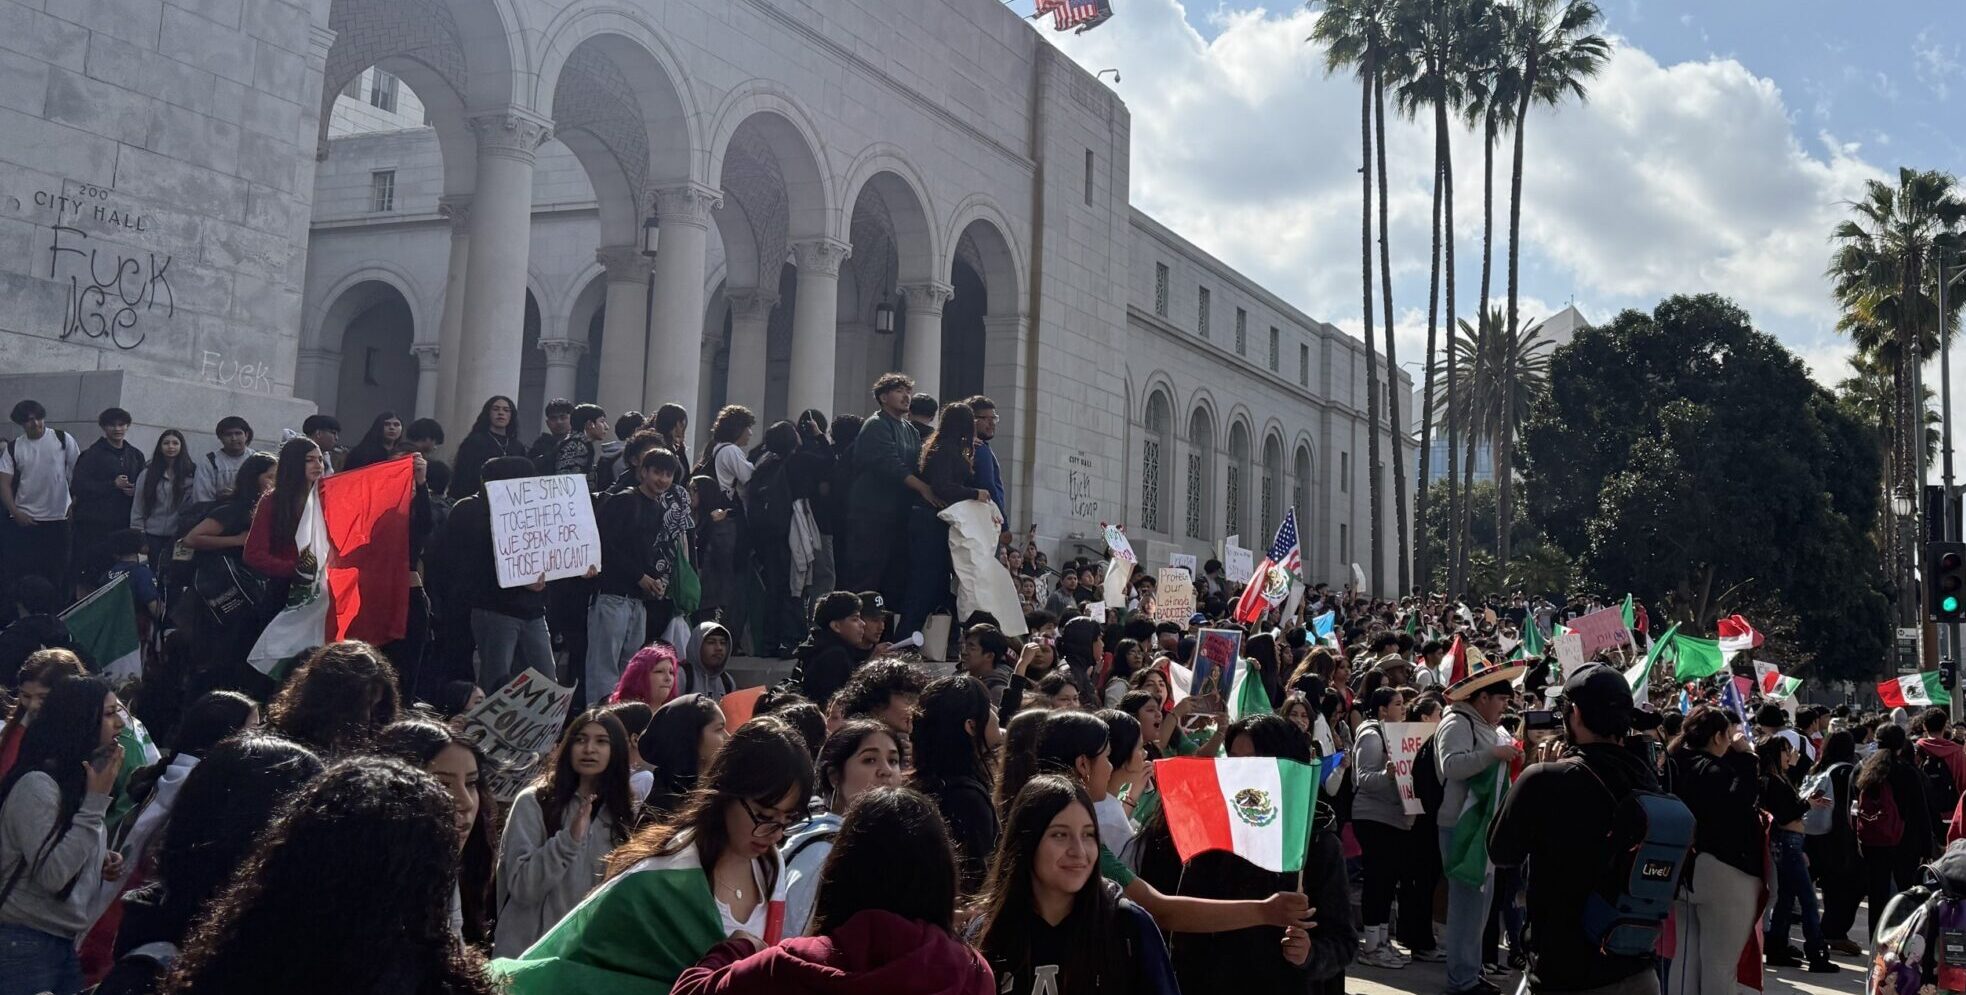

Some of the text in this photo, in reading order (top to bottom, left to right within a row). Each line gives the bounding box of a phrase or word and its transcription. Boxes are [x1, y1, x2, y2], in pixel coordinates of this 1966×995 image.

[79, 185, 108, 200] 200
[34, 191, 145, 232] CITY HALL
[506, 476, 577, 507] WE STAND
[499, 503, 564, 533] TOGETHER
[498, 523, 580, 556] WE SPEAK FOR
[505, 551, 540, 580] THOSE
[543, 548, 562, 573] WHO
[1402, 737, 1422, 753] ARE
